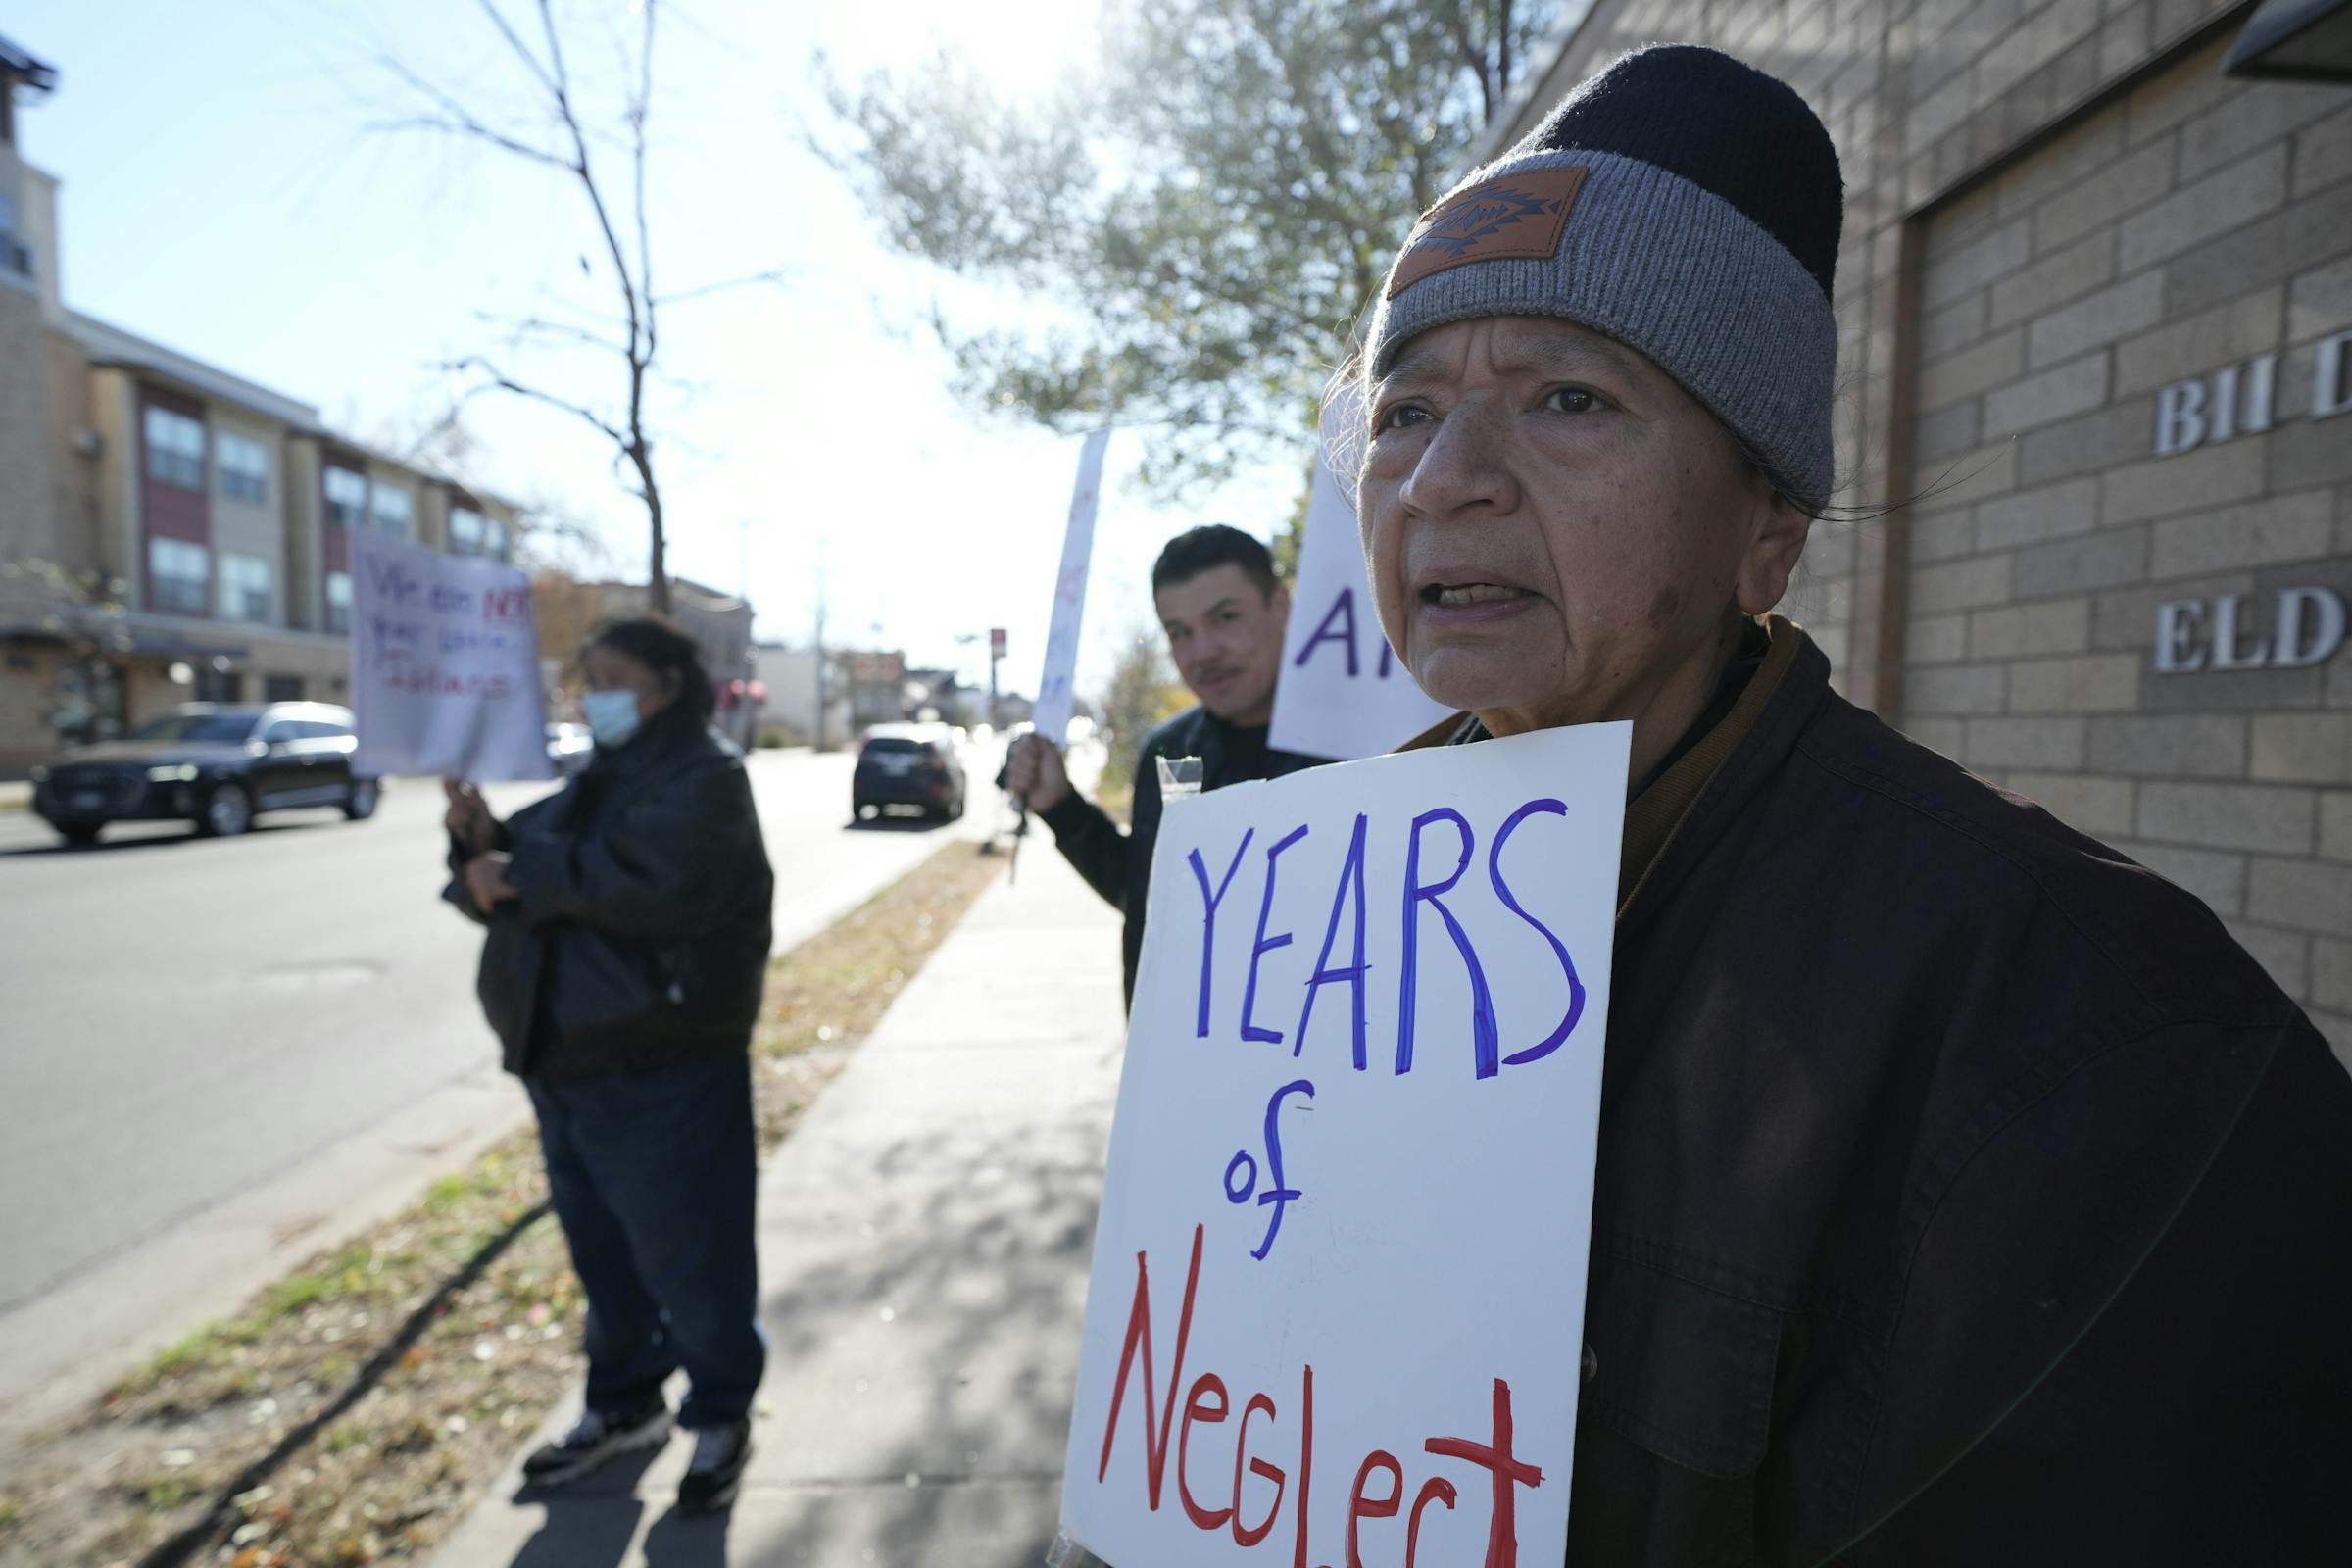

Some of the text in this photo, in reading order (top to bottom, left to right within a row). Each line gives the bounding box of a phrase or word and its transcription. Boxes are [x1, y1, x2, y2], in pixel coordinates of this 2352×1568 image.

[2153, 352, 2277, 456] BII
[1187, 798, 1585, 1079] YEARS
[1223, 1079, 1314, 1261] of
